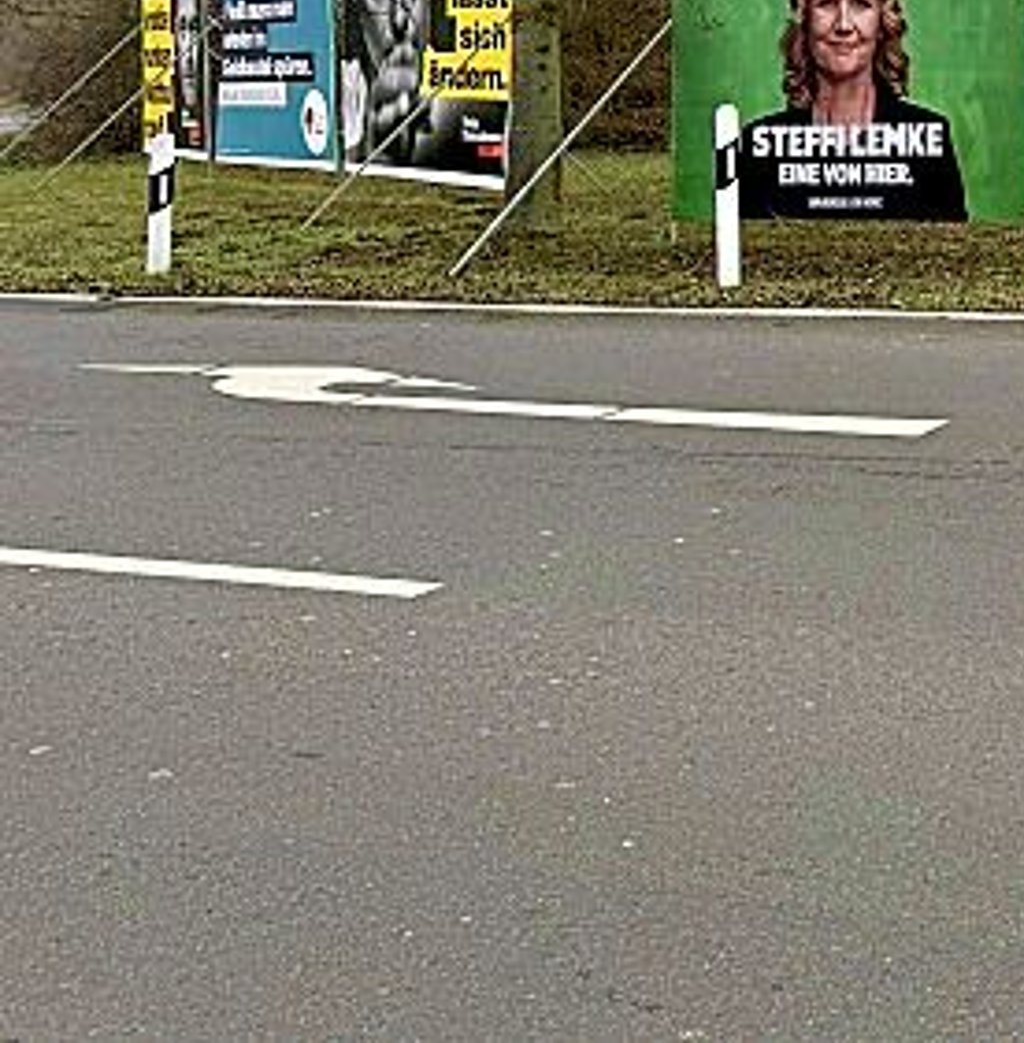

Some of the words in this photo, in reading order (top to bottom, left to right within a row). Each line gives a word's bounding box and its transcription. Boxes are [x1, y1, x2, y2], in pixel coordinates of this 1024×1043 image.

[428, 61, 507, 91] ändern.
[752, 125, 846, 157] STEFFI
[850, 122, 944, 157] LEMKE
[778, 163, 821, 185] EINE
[823, 163, 862, 186] VON
